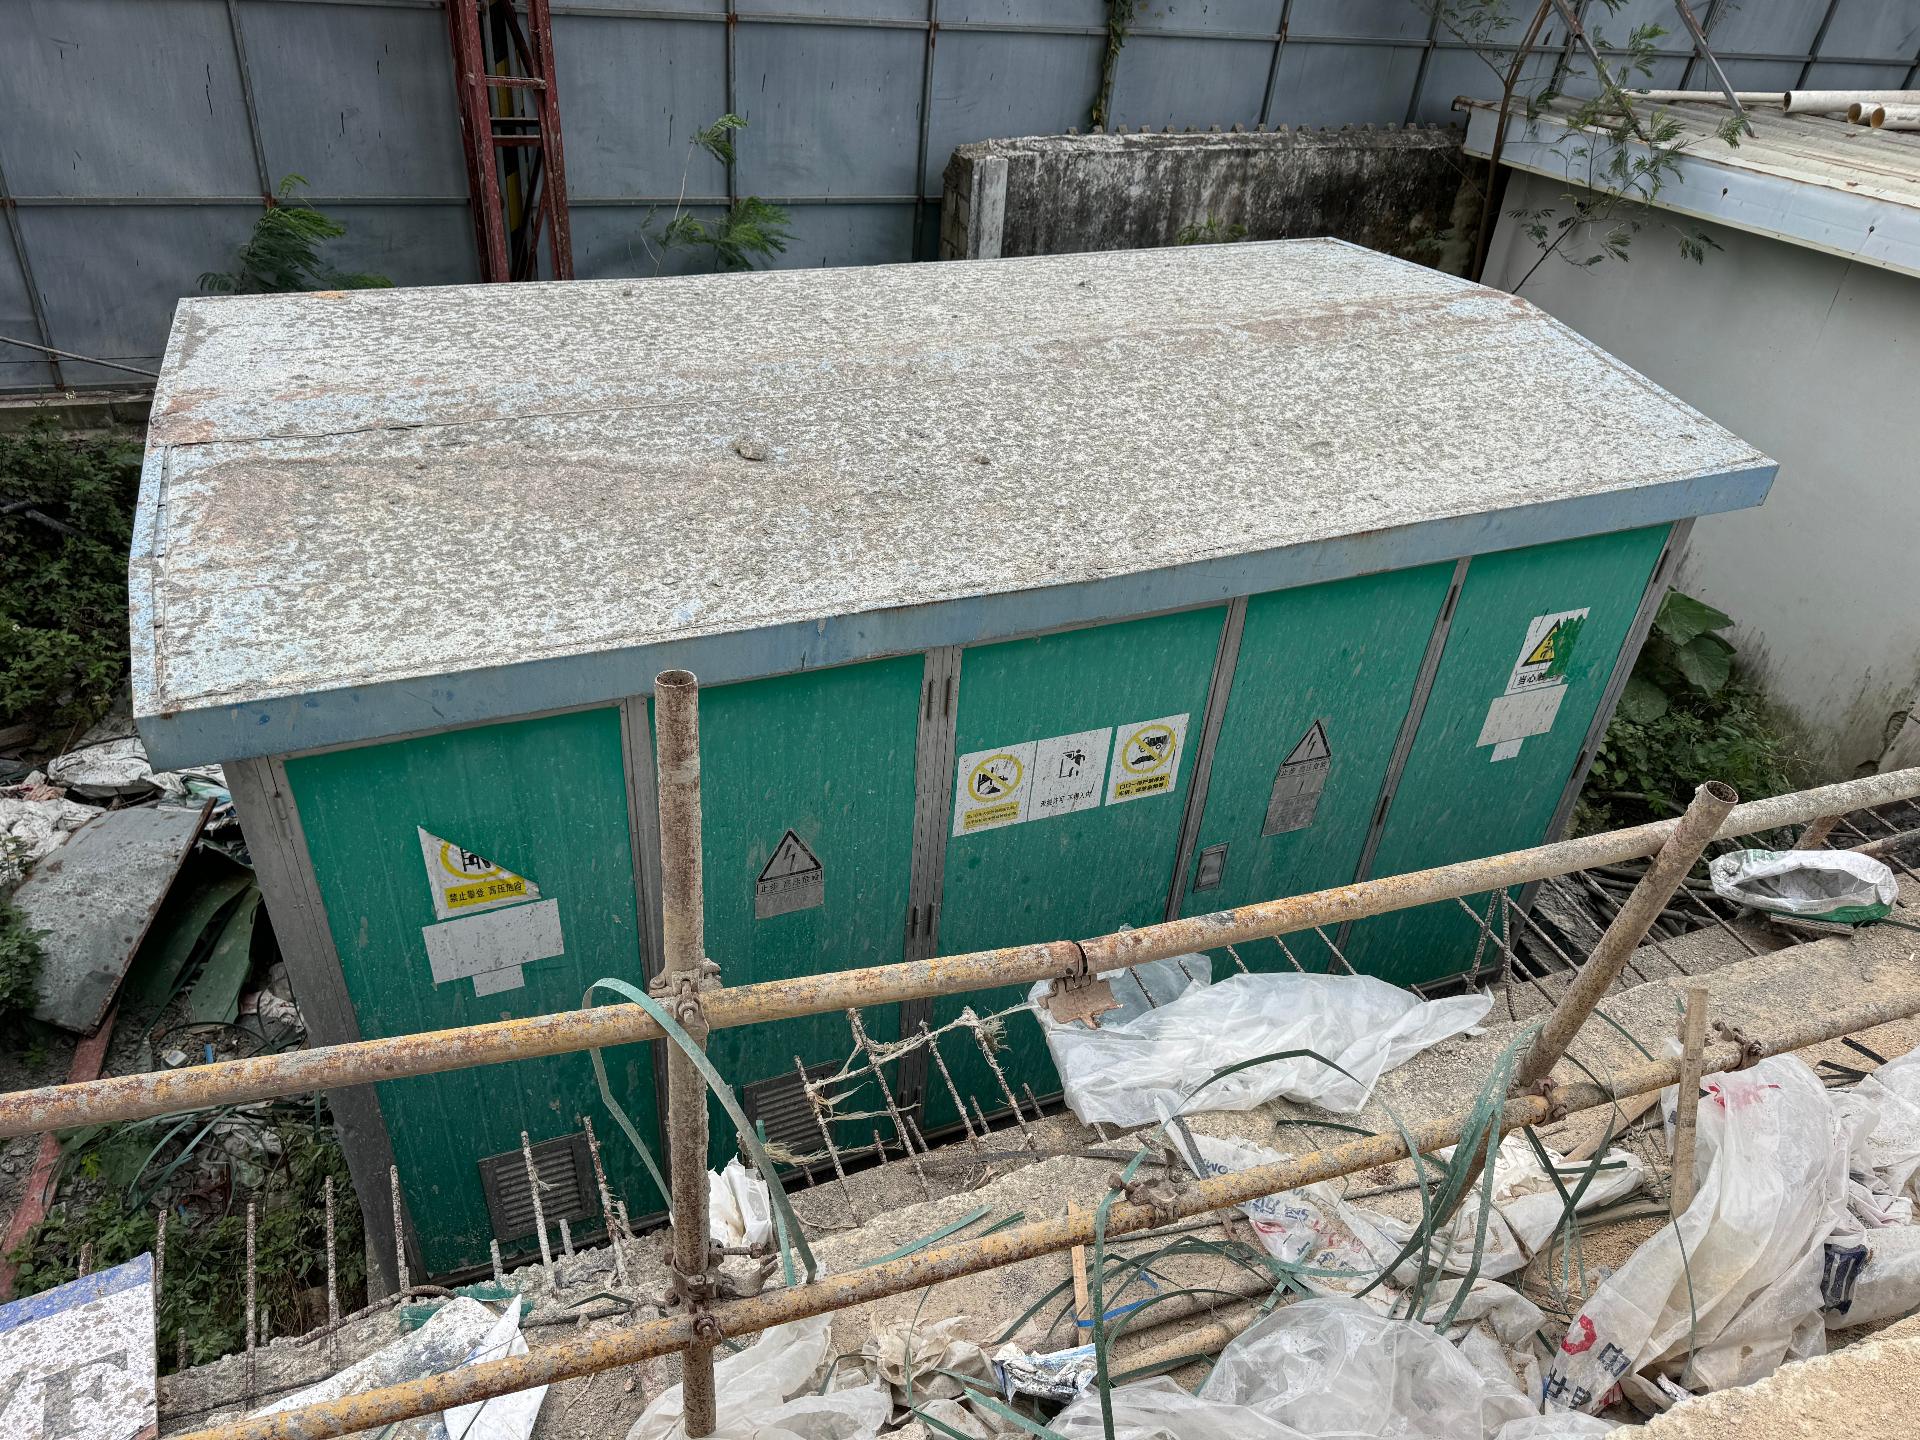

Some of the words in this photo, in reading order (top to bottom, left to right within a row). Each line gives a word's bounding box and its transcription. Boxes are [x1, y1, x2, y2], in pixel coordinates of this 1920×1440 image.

[449, 887, 485, 903] 禁止攀登
[487, 880, 523, 896] 高压危险
